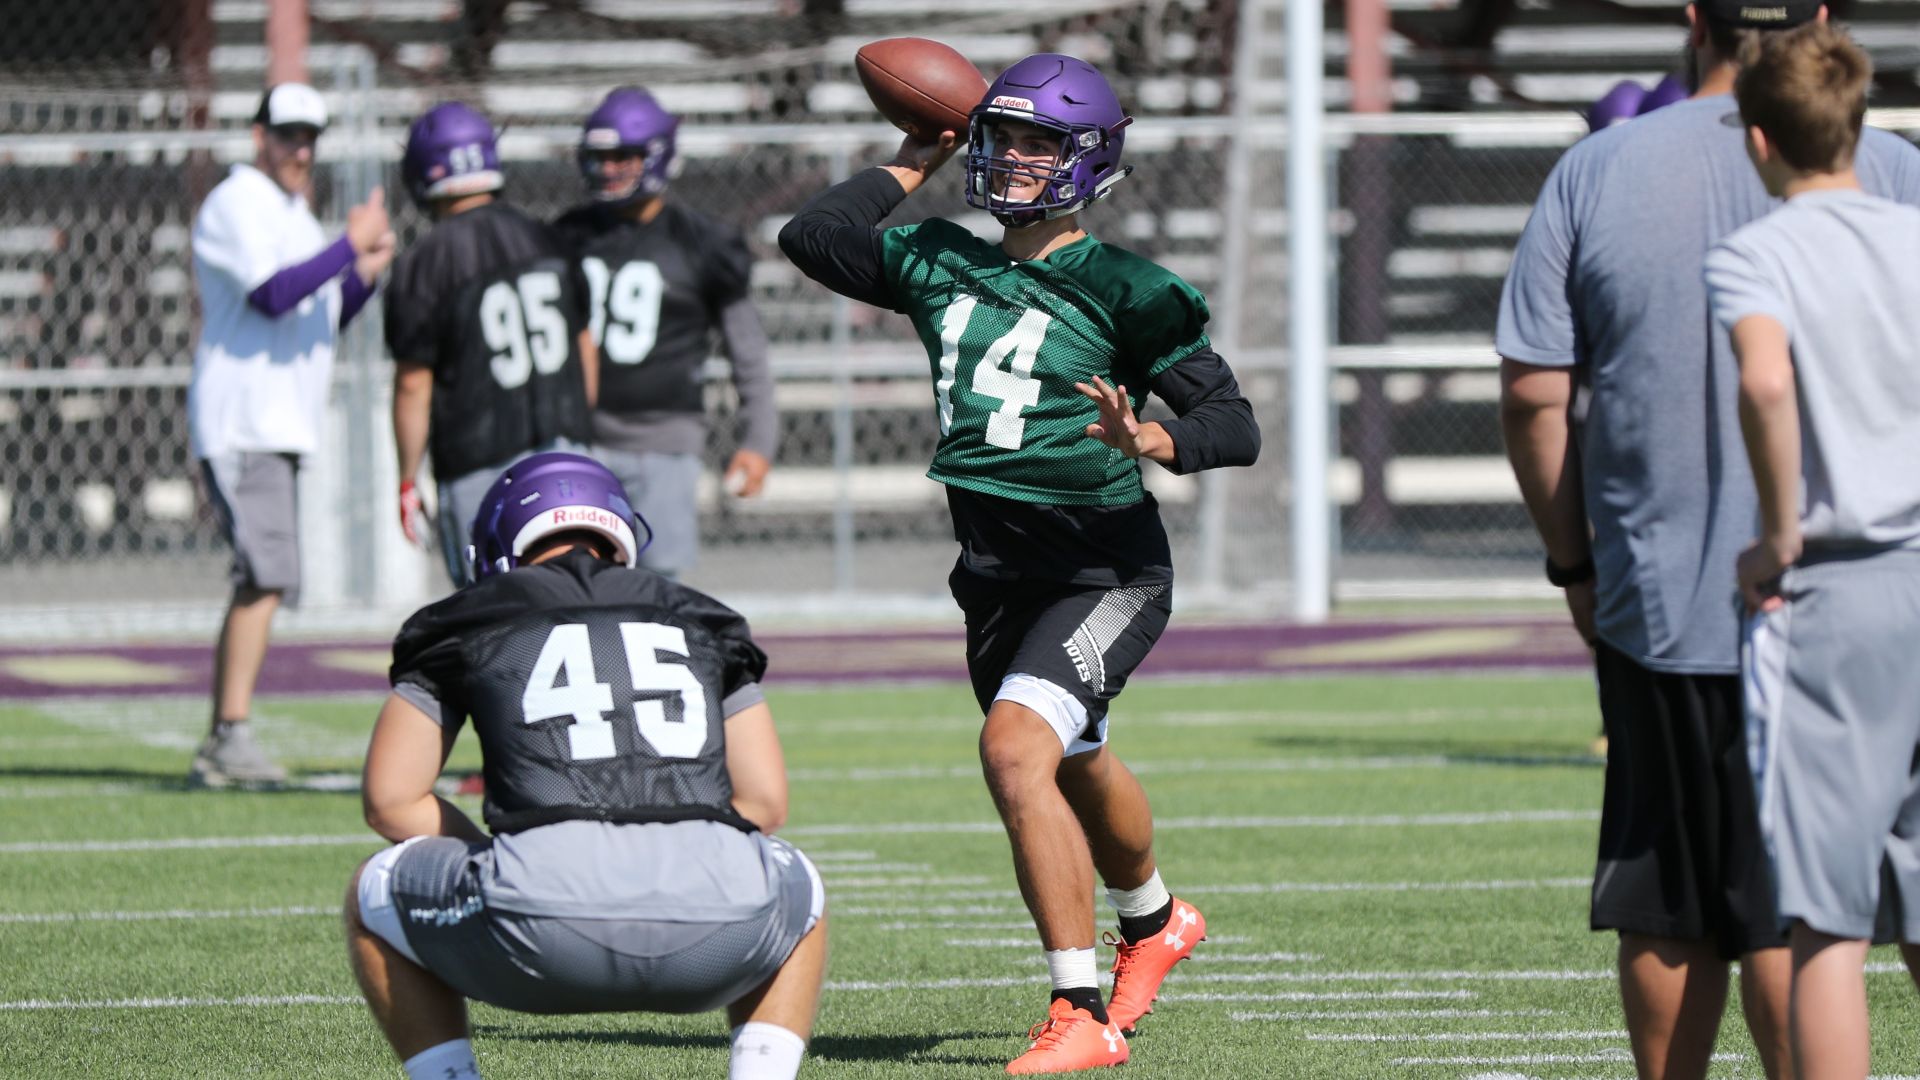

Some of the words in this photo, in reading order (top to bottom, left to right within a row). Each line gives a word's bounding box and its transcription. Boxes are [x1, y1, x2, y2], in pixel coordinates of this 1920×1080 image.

[995, 97, 1029, 109] Riddell
[479, 271, 569, 389] 95
[936, 293, 1052, 450] 14
[553, 507, 620, 531] Riddell
[522, 621, 708, 761] 45
[1062, 637, 1091, 682] YOTES
